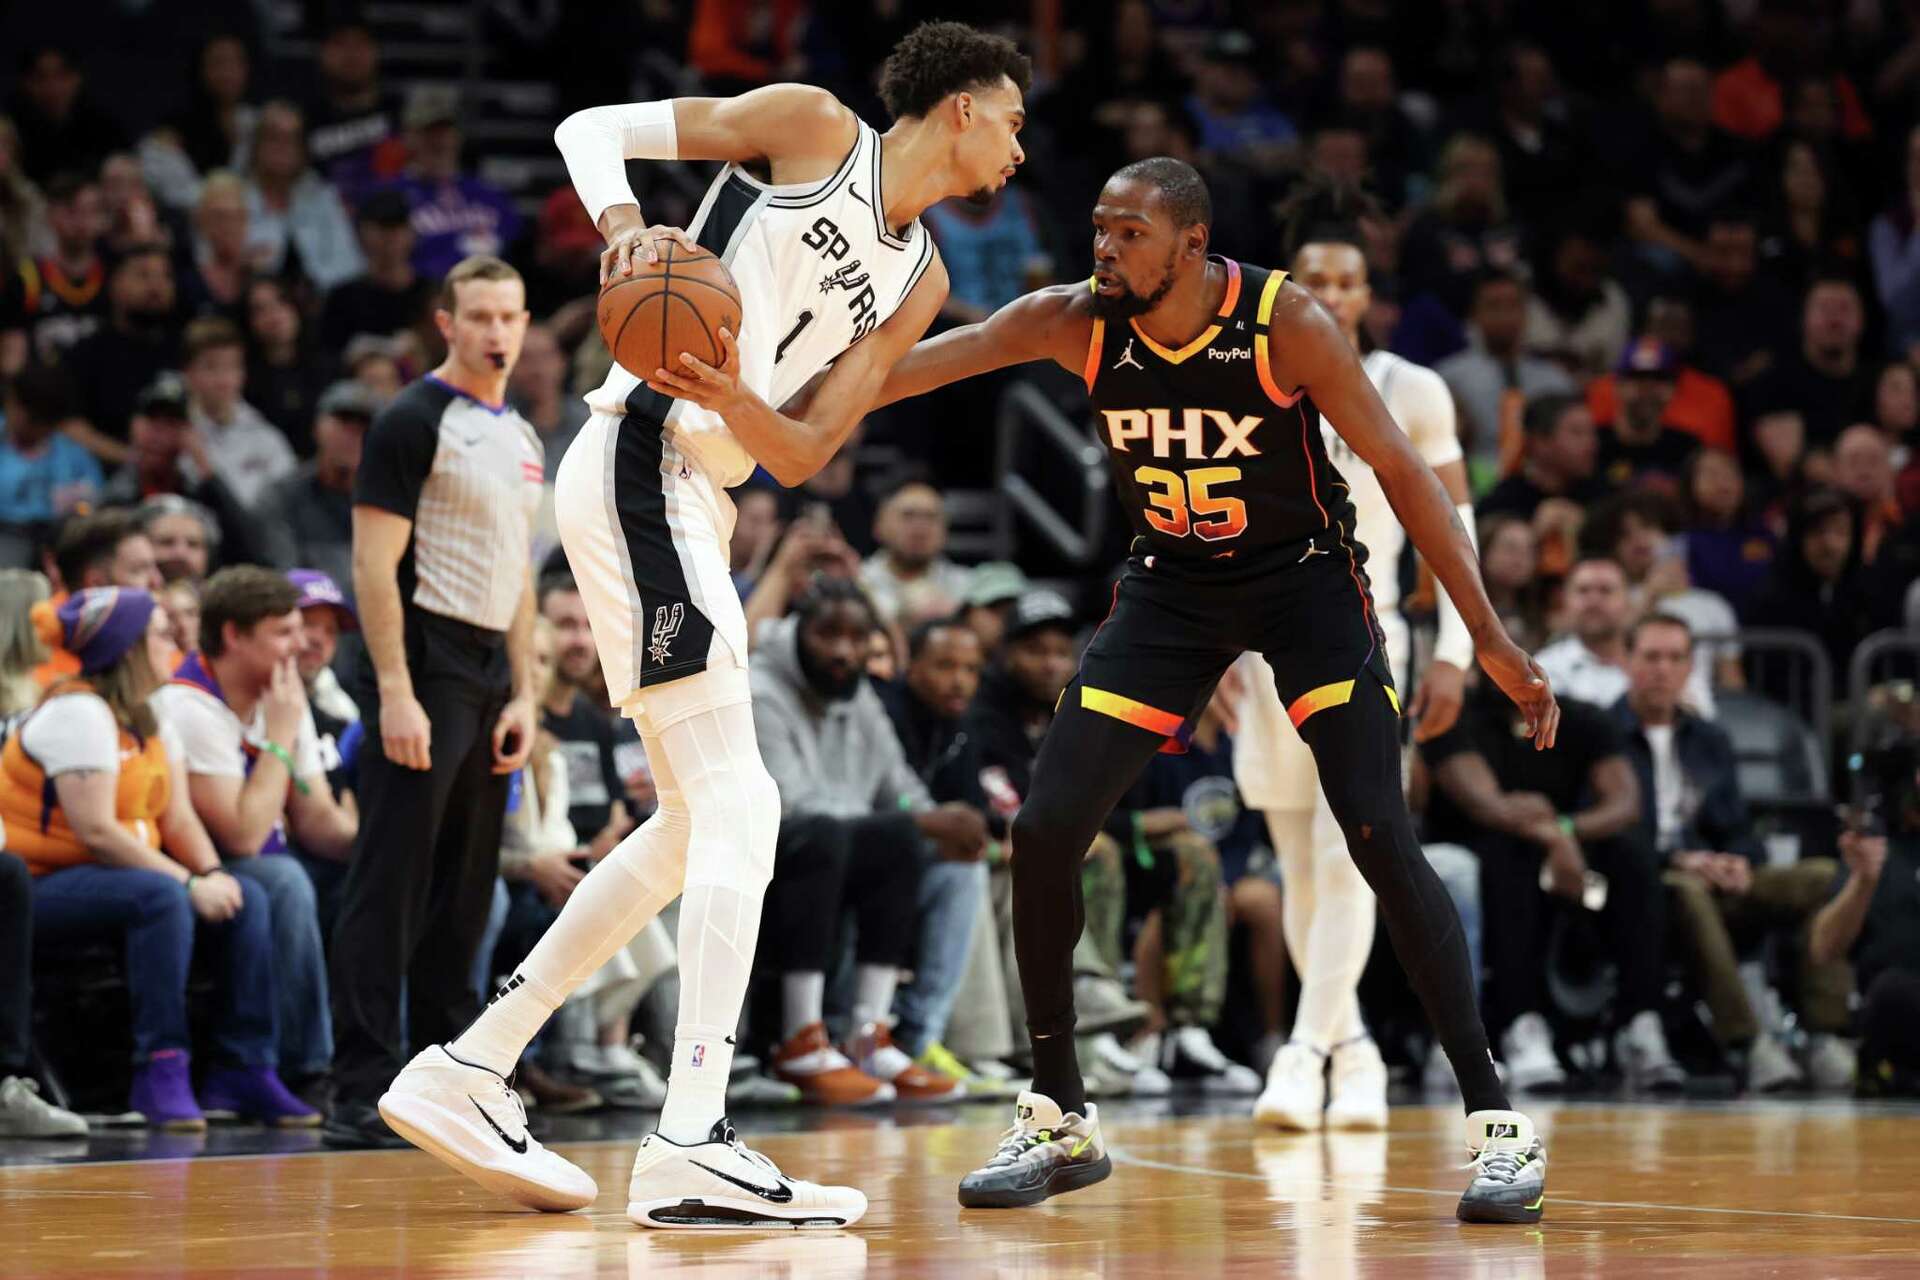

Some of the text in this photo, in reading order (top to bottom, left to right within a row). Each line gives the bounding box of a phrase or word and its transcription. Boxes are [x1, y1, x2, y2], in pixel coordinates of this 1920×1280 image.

[774, 310, 814, 365] 1
[1208, 347, 1251, 363] PayPal
[1101, 408, 1264, 460] PHX
[1134, 465, 1248, 542] 35
